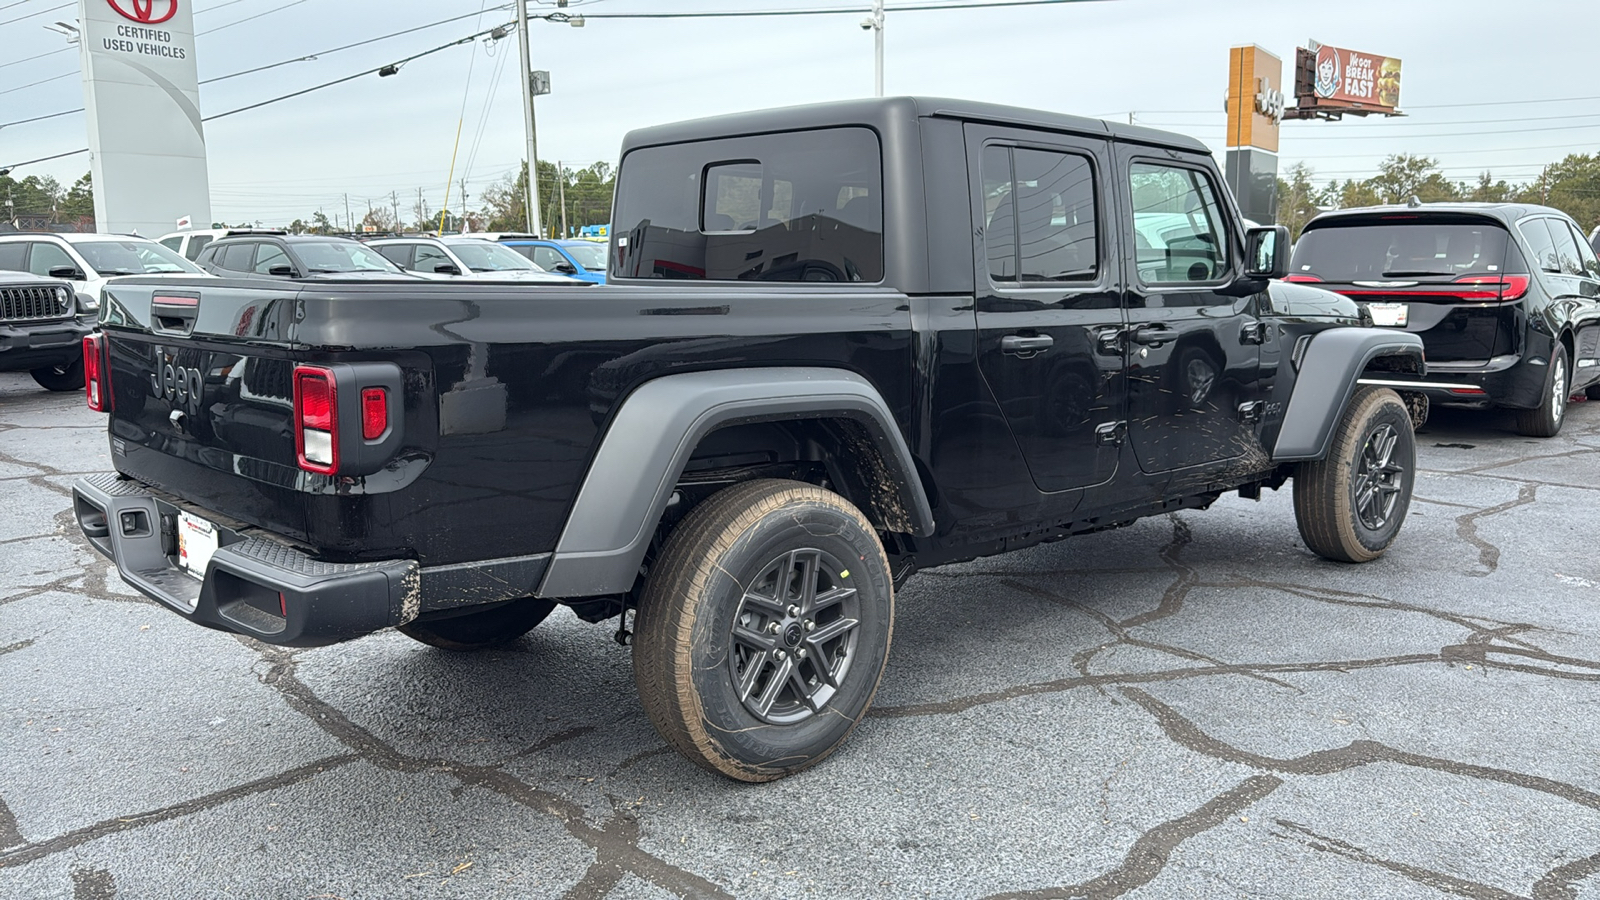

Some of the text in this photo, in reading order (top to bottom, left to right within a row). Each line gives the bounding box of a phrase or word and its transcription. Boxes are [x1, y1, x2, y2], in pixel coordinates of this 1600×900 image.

[117, 25, 171, 43] CERTIFIED
[103, 38, 186, 60] USED VEHICLES
[1359, 57, 1372, 68] GOT
[1346, 65, 1374, 81] BREAK
[1345, 78, 1374, 98] FAST
[1256, 77, 1284, 126] Jeep
[150, 345, 203, 416] Jeep
